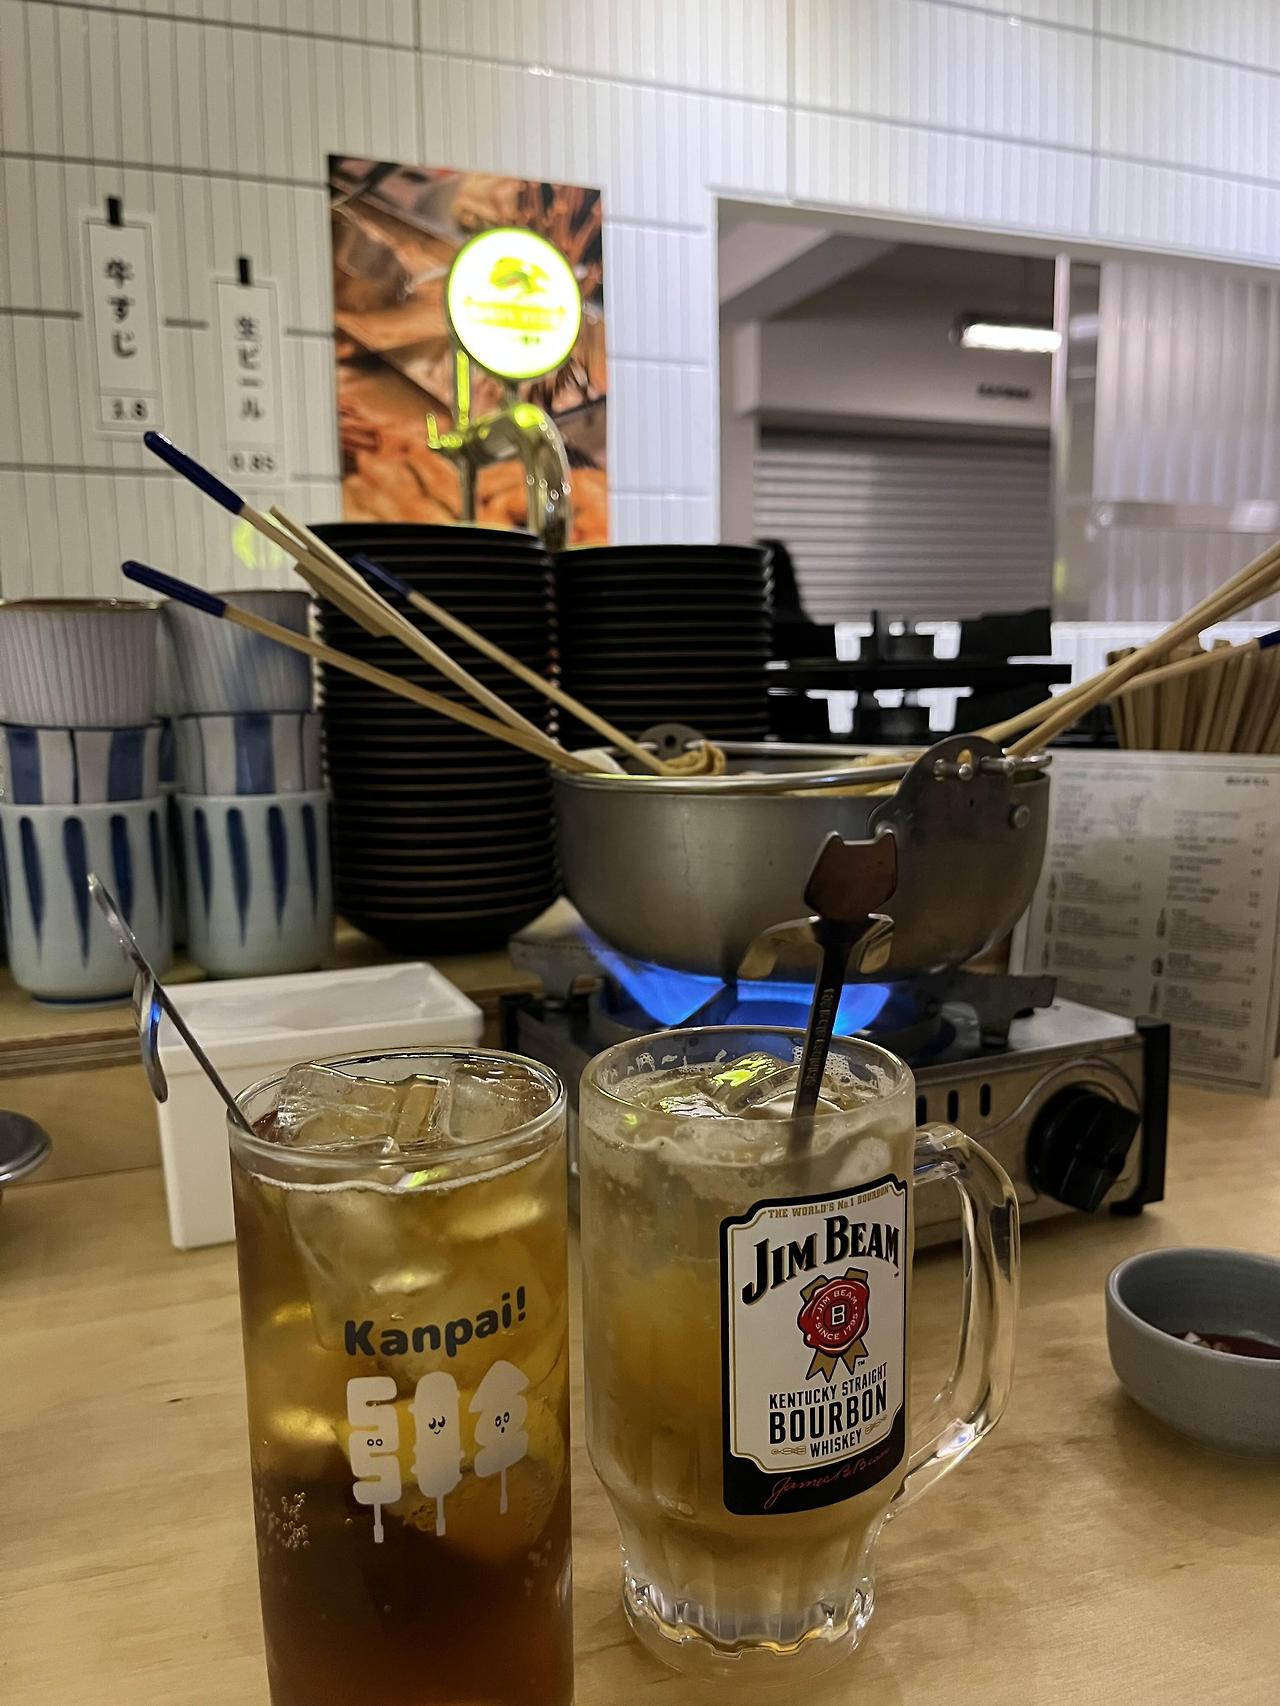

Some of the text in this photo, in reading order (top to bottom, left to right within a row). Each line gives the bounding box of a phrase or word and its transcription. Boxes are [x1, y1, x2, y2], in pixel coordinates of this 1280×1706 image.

[768, 1209, 788, 1219] THE
[791, 1202, 835, 1217] WORLD'S
[857, 1185, 889, 1204] BOURBON
[742, 1215, 900, 1306] JIM BEAM
[817, 1289, 858, 1313] JIM BEAM
[831, 1304, 845, 1326] B
[344, 1286, 526, 1357] Kanpai!
[815, 1313, 859, 1340] SINCE 1795
[769, 1362, 888, 1410] KENTUCKY STRAIGHT
[769, 1379, 888, 1445] BOURBON
[809, 1428, 863, 1458] WHISKEY
